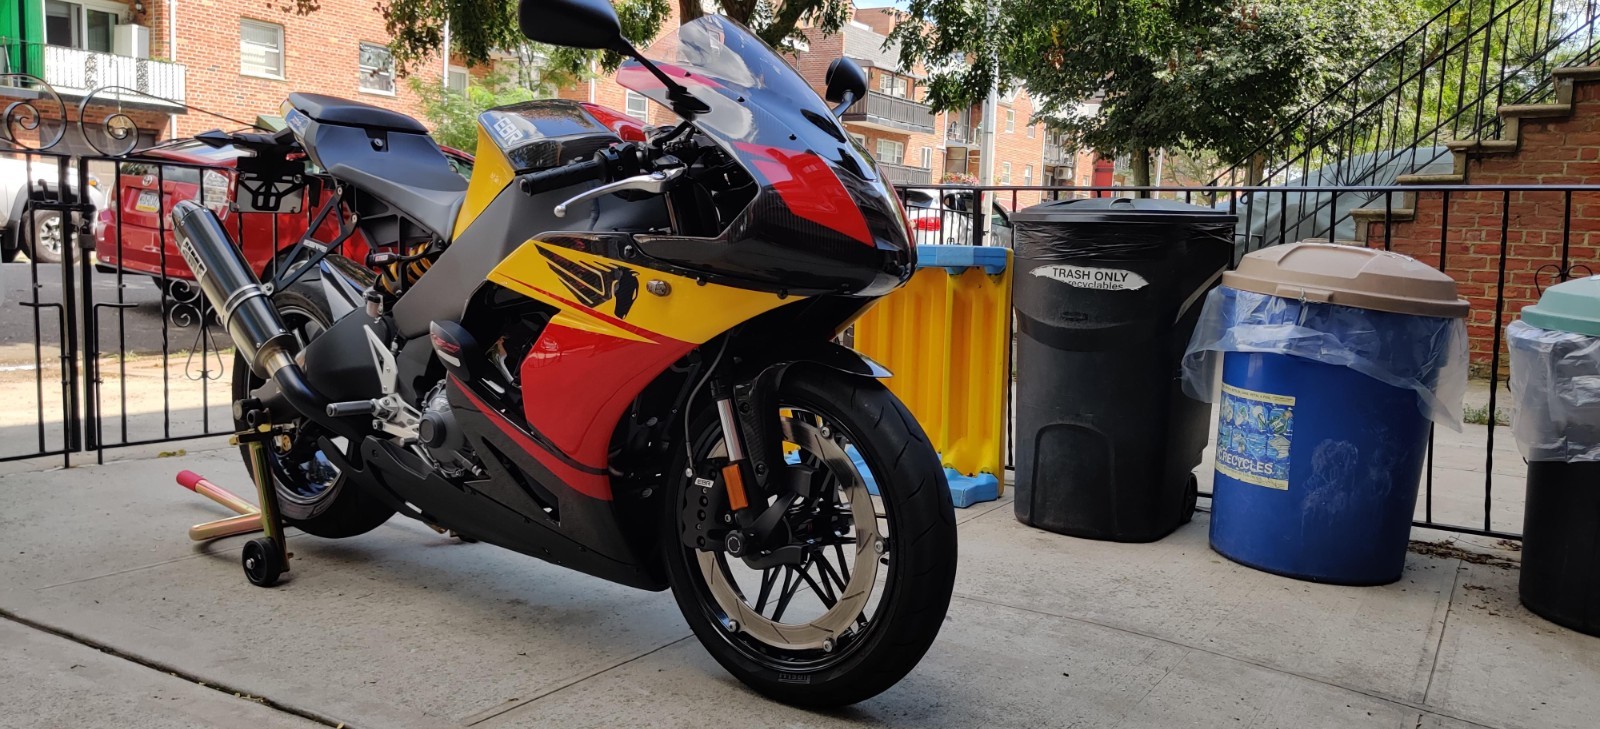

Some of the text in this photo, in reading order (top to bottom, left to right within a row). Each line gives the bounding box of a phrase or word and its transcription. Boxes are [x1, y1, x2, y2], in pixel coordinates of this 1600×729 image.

[493, 117, 523, 145] EBR
[1053, 267, 1128, 282] TRASH ONLY
[1223, 452, 1273, 475] RECYCLES
